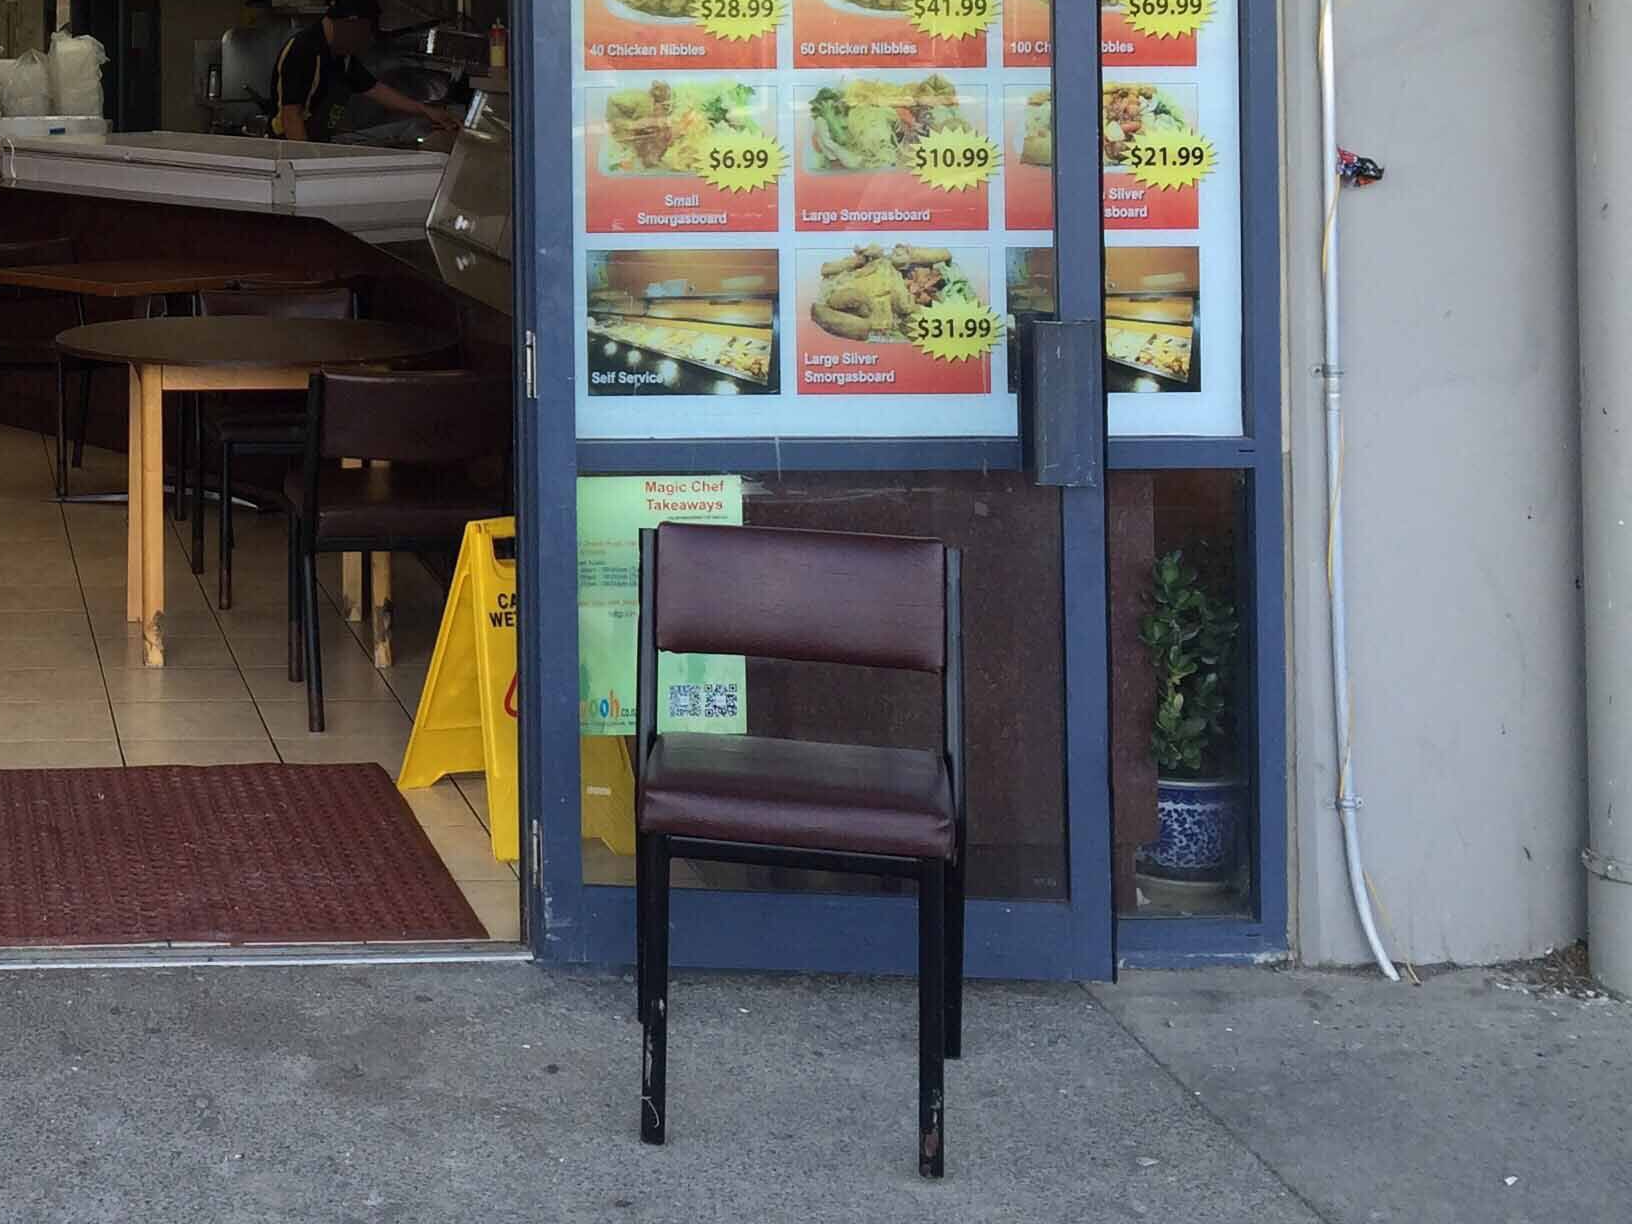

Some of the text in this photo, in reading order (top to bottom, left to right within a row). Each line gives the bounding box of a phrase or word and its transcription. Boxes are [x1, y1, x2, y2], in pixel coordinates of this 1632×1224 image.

[590, 43, 705, 56] 40 Chicken Nibbles
[800, 43, 917, 56] 60 Chicken Nibbles
[1010, 41, 1031, 53] 100
[709, 149, 768, 171] $6.99
[915, 147, 988, 170] $10.99
[1131, 145, 1204, 168] $21.99
[664, 194, 699, 207] Small
[1109, 187, 1145, 200] Silver
[637, 212, 727, 226] Smorgasboard
[802, 209, 930, 223] Large Smorgasboard
[917, 317, 990, 340] $31.99
[804, 352, 878, 367] Large Silver
[592, 371, 664, 384] Self Service
[804, 370, 894, 385] Smorgasboard
[645, 480, 724, 495] Magic Chef
[647, 499, 723, 513] Takeaways
